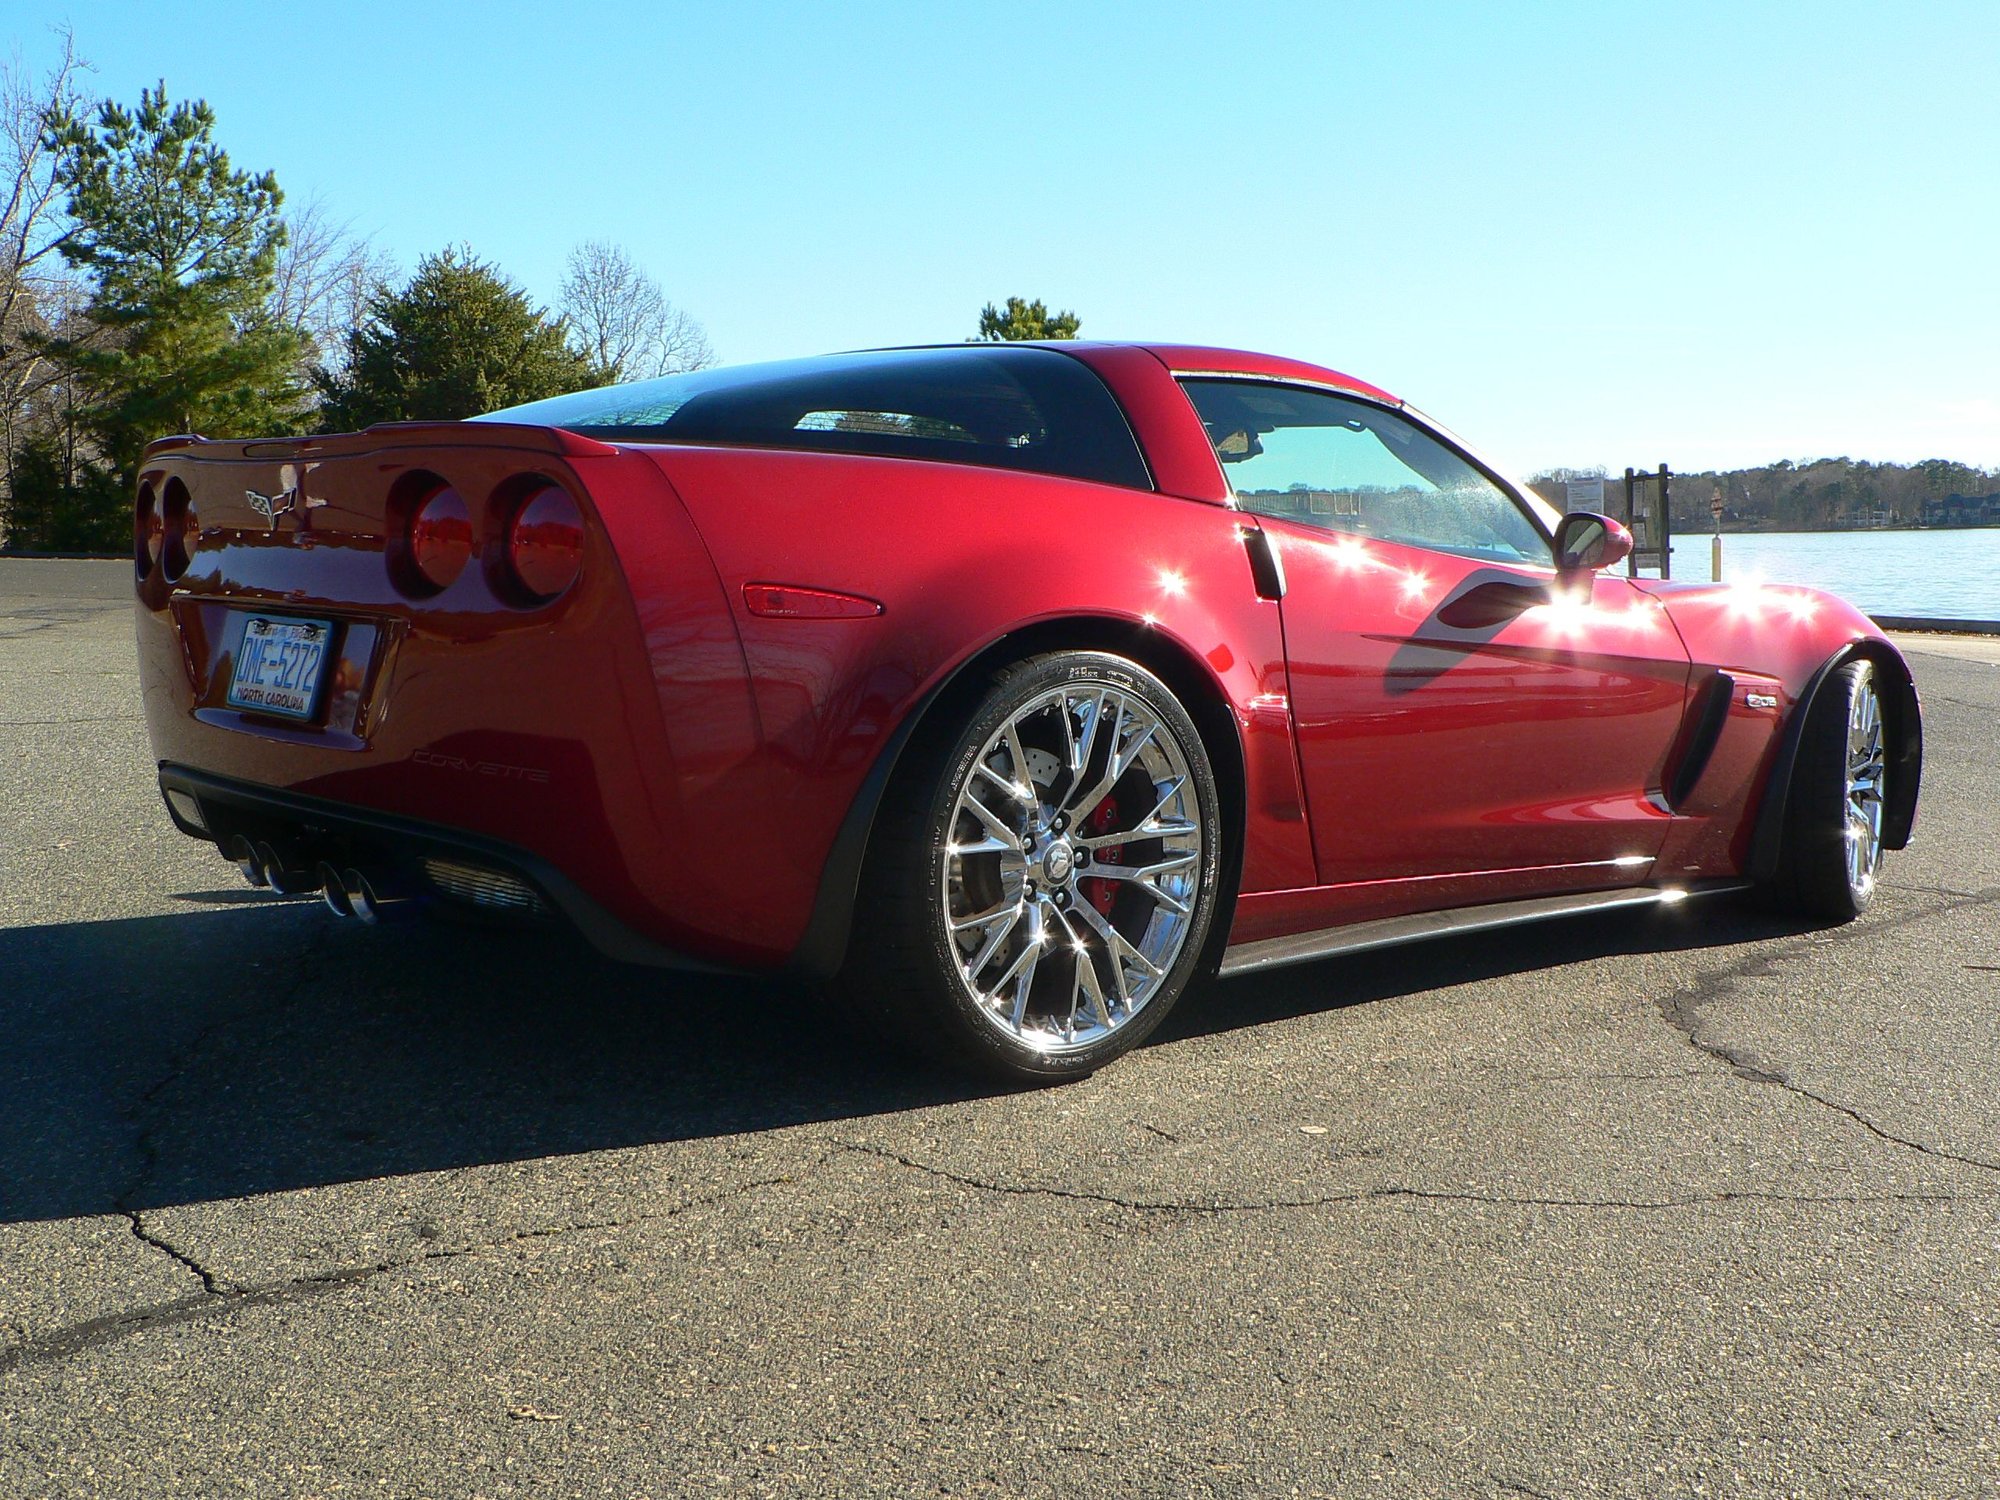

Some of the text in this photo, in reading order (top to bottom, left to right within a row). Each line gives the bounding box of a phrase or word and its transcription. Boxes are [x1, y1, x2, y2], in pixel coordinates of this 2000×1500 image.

[237, 687, 304, 711] NORTH CAROLINA
[412, 749, 550, 783] CORVETTE
